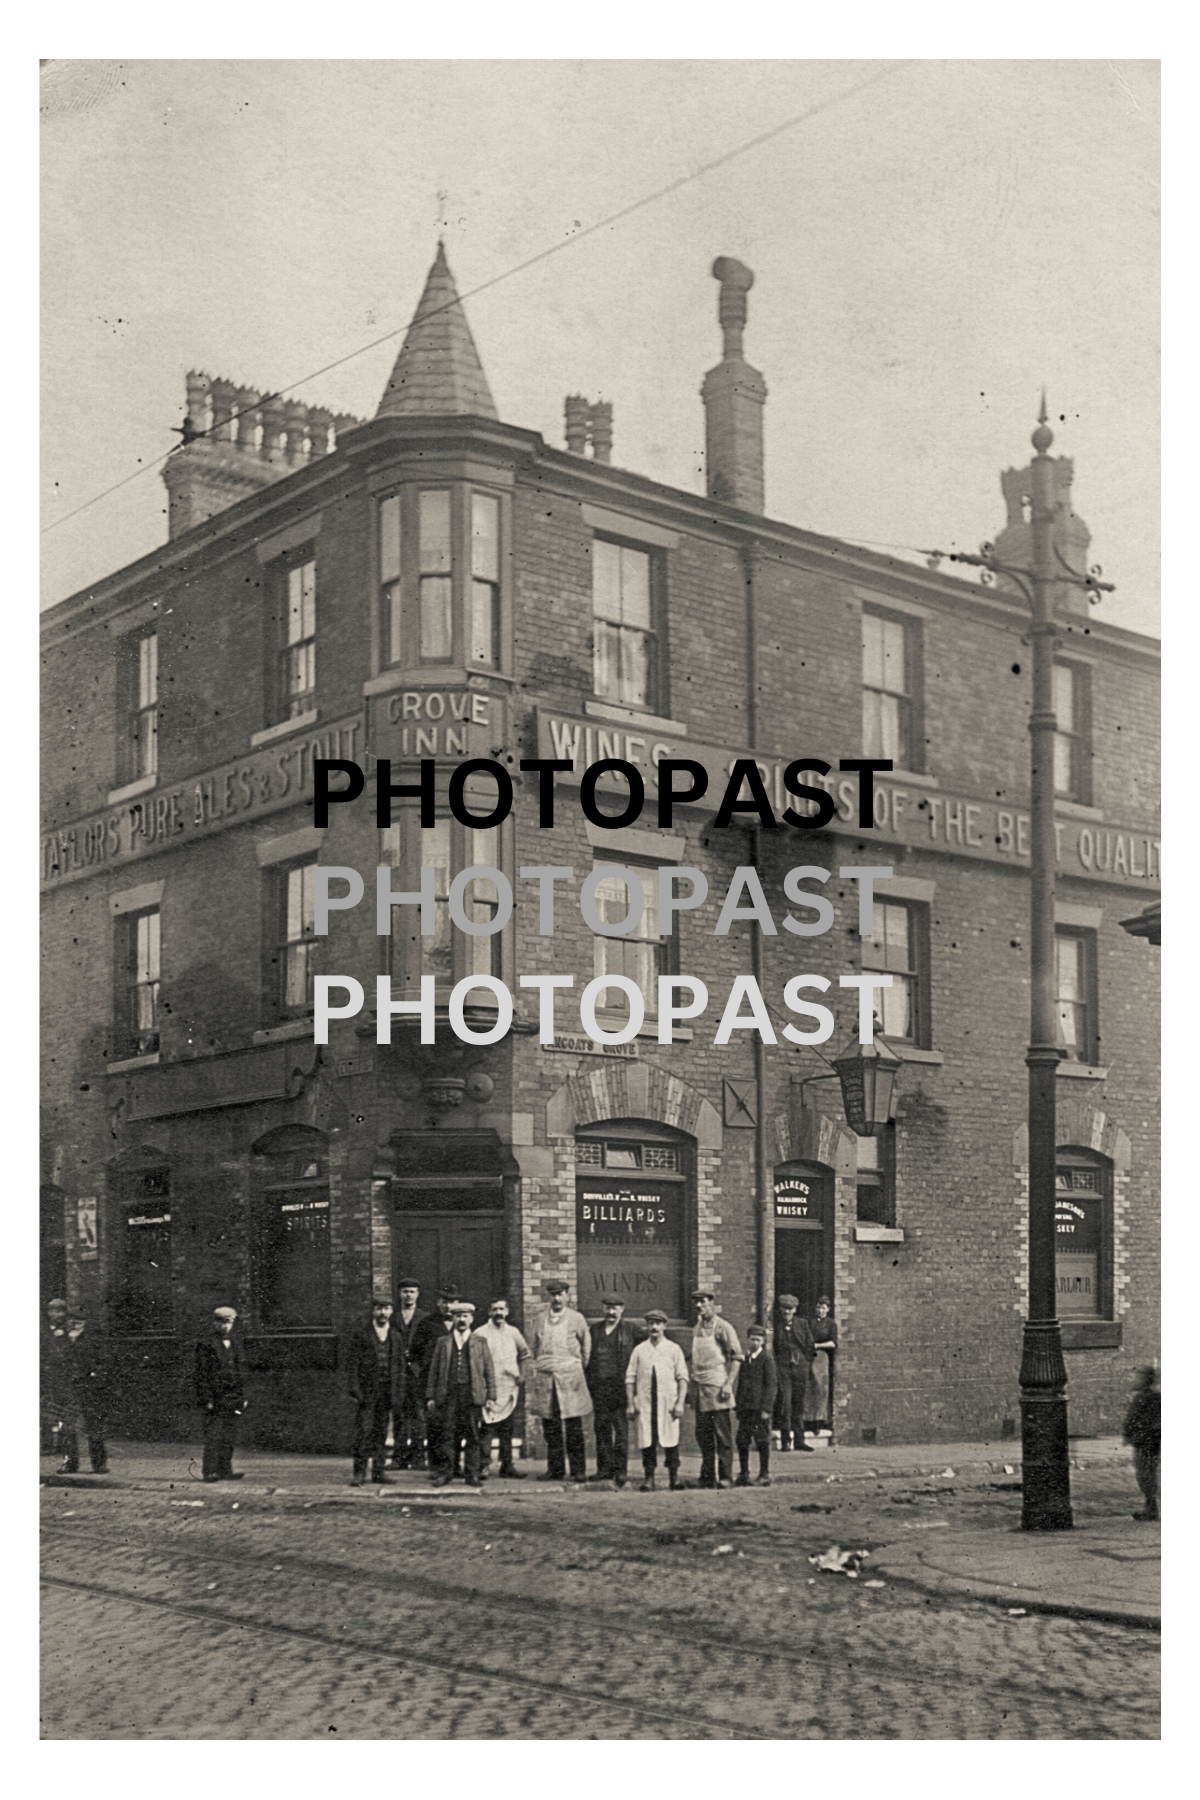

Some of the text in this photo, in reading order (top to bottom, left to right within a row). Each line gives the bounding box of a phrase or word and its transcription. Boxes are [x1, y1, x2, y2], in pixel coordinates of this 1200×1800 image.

[388, 692, 489, 726] GROVE
[402, 727, 468, 755] INN
[128, 792, 184, 850] PURE
[194, 766, 253, 823] ALES
[872, 787, 908, 832] OF
[925, 797, 983, 847] THE
[998, 810, 1065, 862] BET
[583, 1205, 666, 1223] BILLIARDS
[776, 1206, 808, 1215] WHISKY
[1056, 1224, 1075, 1233] SKEY
[593, 1273, 658, 1293] WINES
[1055, 1276, 1092, 1294] ARLOUR
